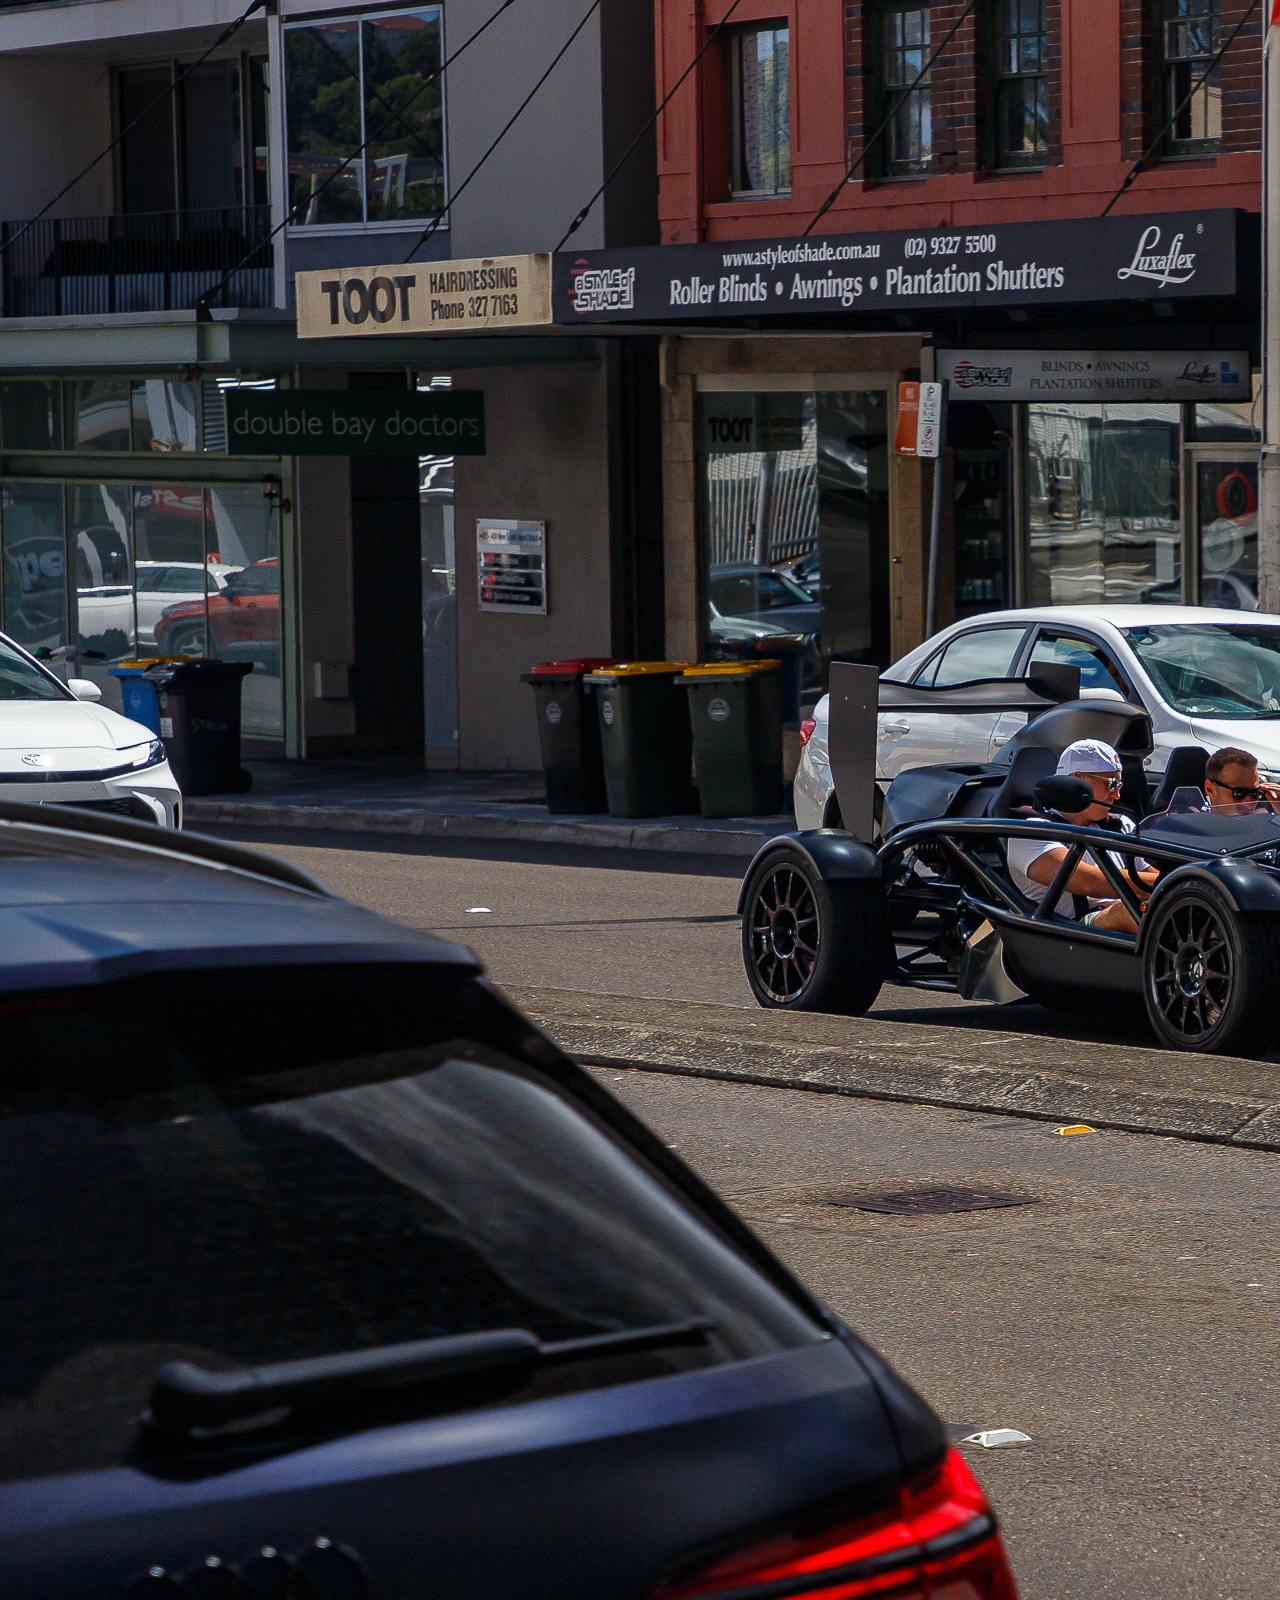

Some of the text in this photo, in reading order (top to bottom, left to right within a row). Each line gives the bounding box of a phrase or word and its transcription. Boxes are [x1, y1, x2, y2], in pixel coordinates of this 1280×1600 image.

[722, 234, 996, 270] www.astyleofshade.com.au (02) 9327 5500
[1117, 226, 1196, 288] Luxaflex
[429, 266, 518, 294] HAIRDRESSING
[584, 271, 620, 290] STYLE
[670, 260, 1065, 307] Roller Blinds Awnings Plantation Shutters
[321, 275, 416, 325] TOOT
[431, 293, 518, 320] Phone 327 7163
[574, 289, 632, 308] SHADE
[1041, 360, 1151, 372] BLINDS AWNINGS
[960, 377, 1010, 387] SHADE
[1029, 377, 1163, 389] PLANTATION SHUTTERS
[233, 408, 480, 443] double bay doctors
[708, 416, 753, 443] TOOT
